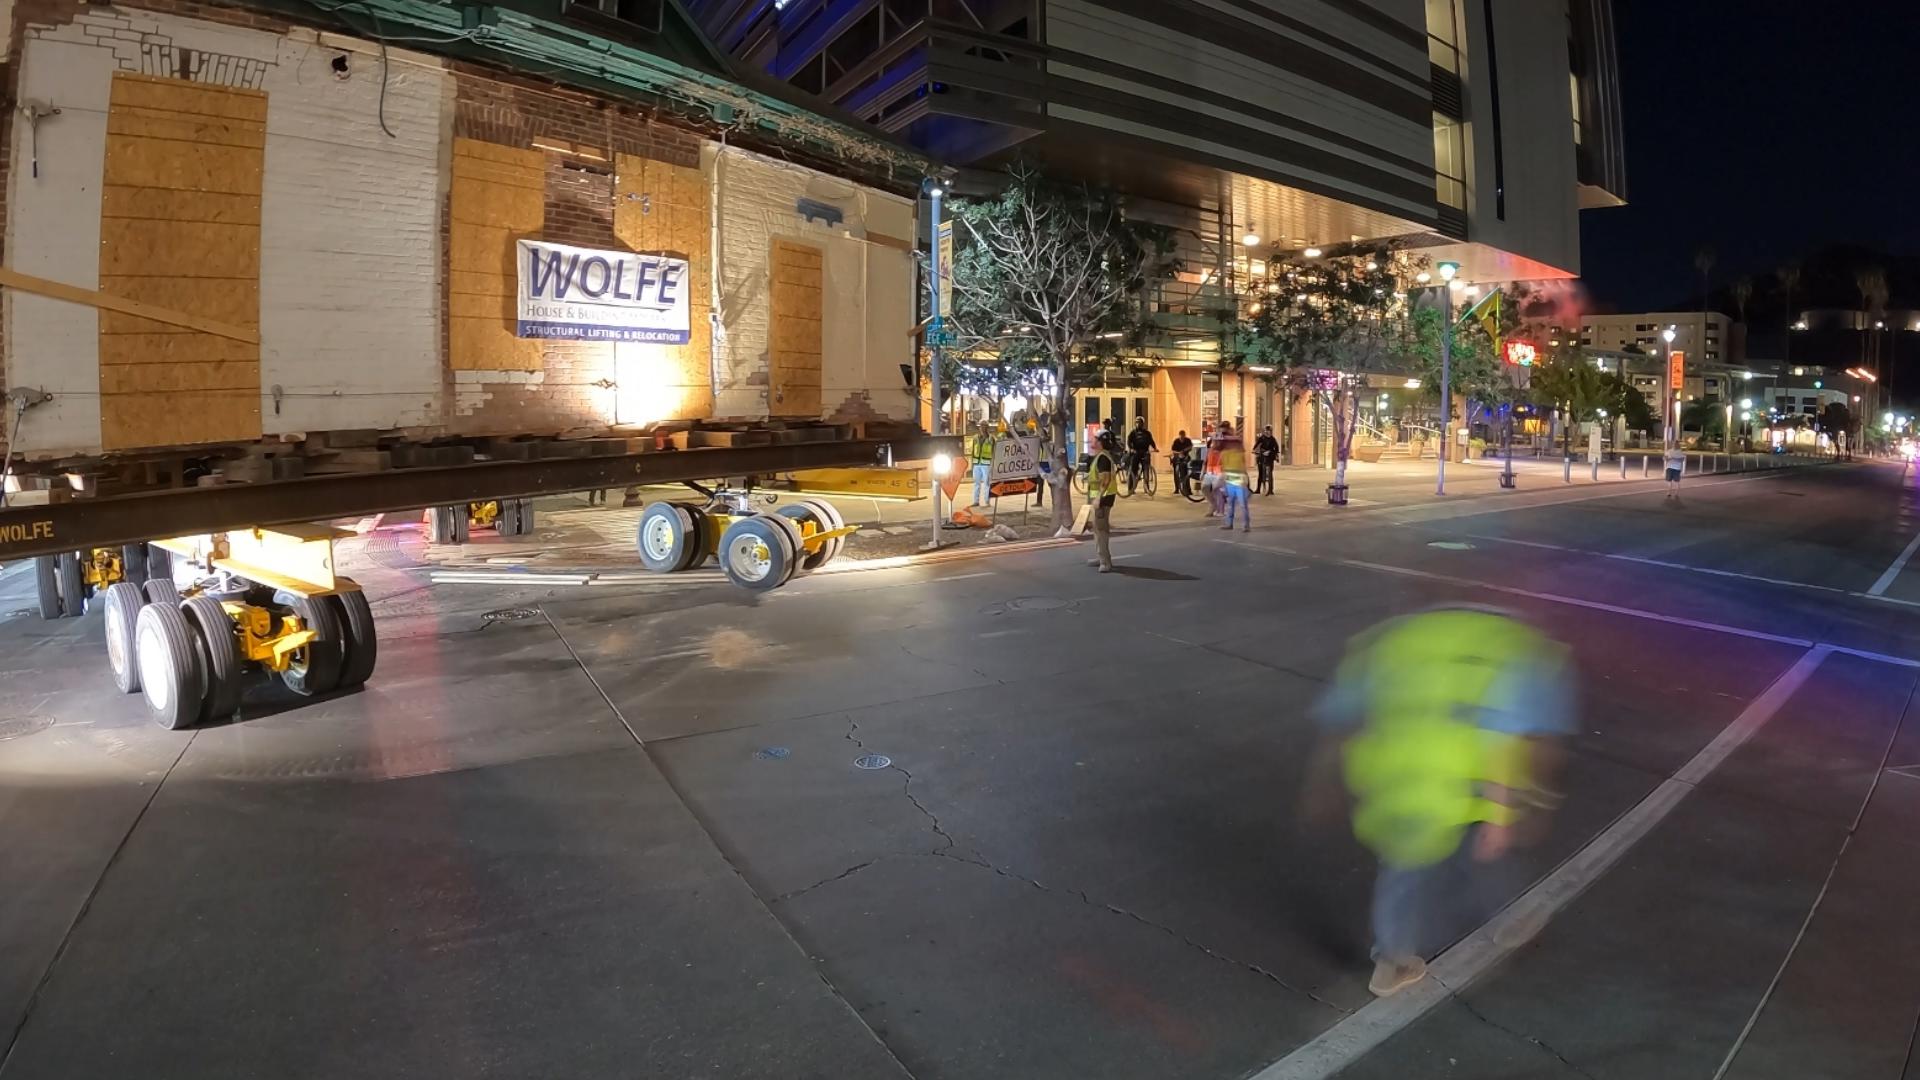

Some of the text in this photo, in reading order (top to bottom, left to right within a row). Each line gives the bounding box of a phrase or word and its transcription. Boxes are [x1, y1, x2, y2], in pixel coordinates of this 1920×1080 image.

[529, 248, 682, 304] WOLFE
[526, 304, 563, 318] HOUSE
[566, 306, 576, 319] &
[526, 325, 680, 341] STRUCTURAL LIFTING & RELOCATION
[997, 459, 1033, 473] CLOSED
[0, 521, 54, 543] WOLFE
